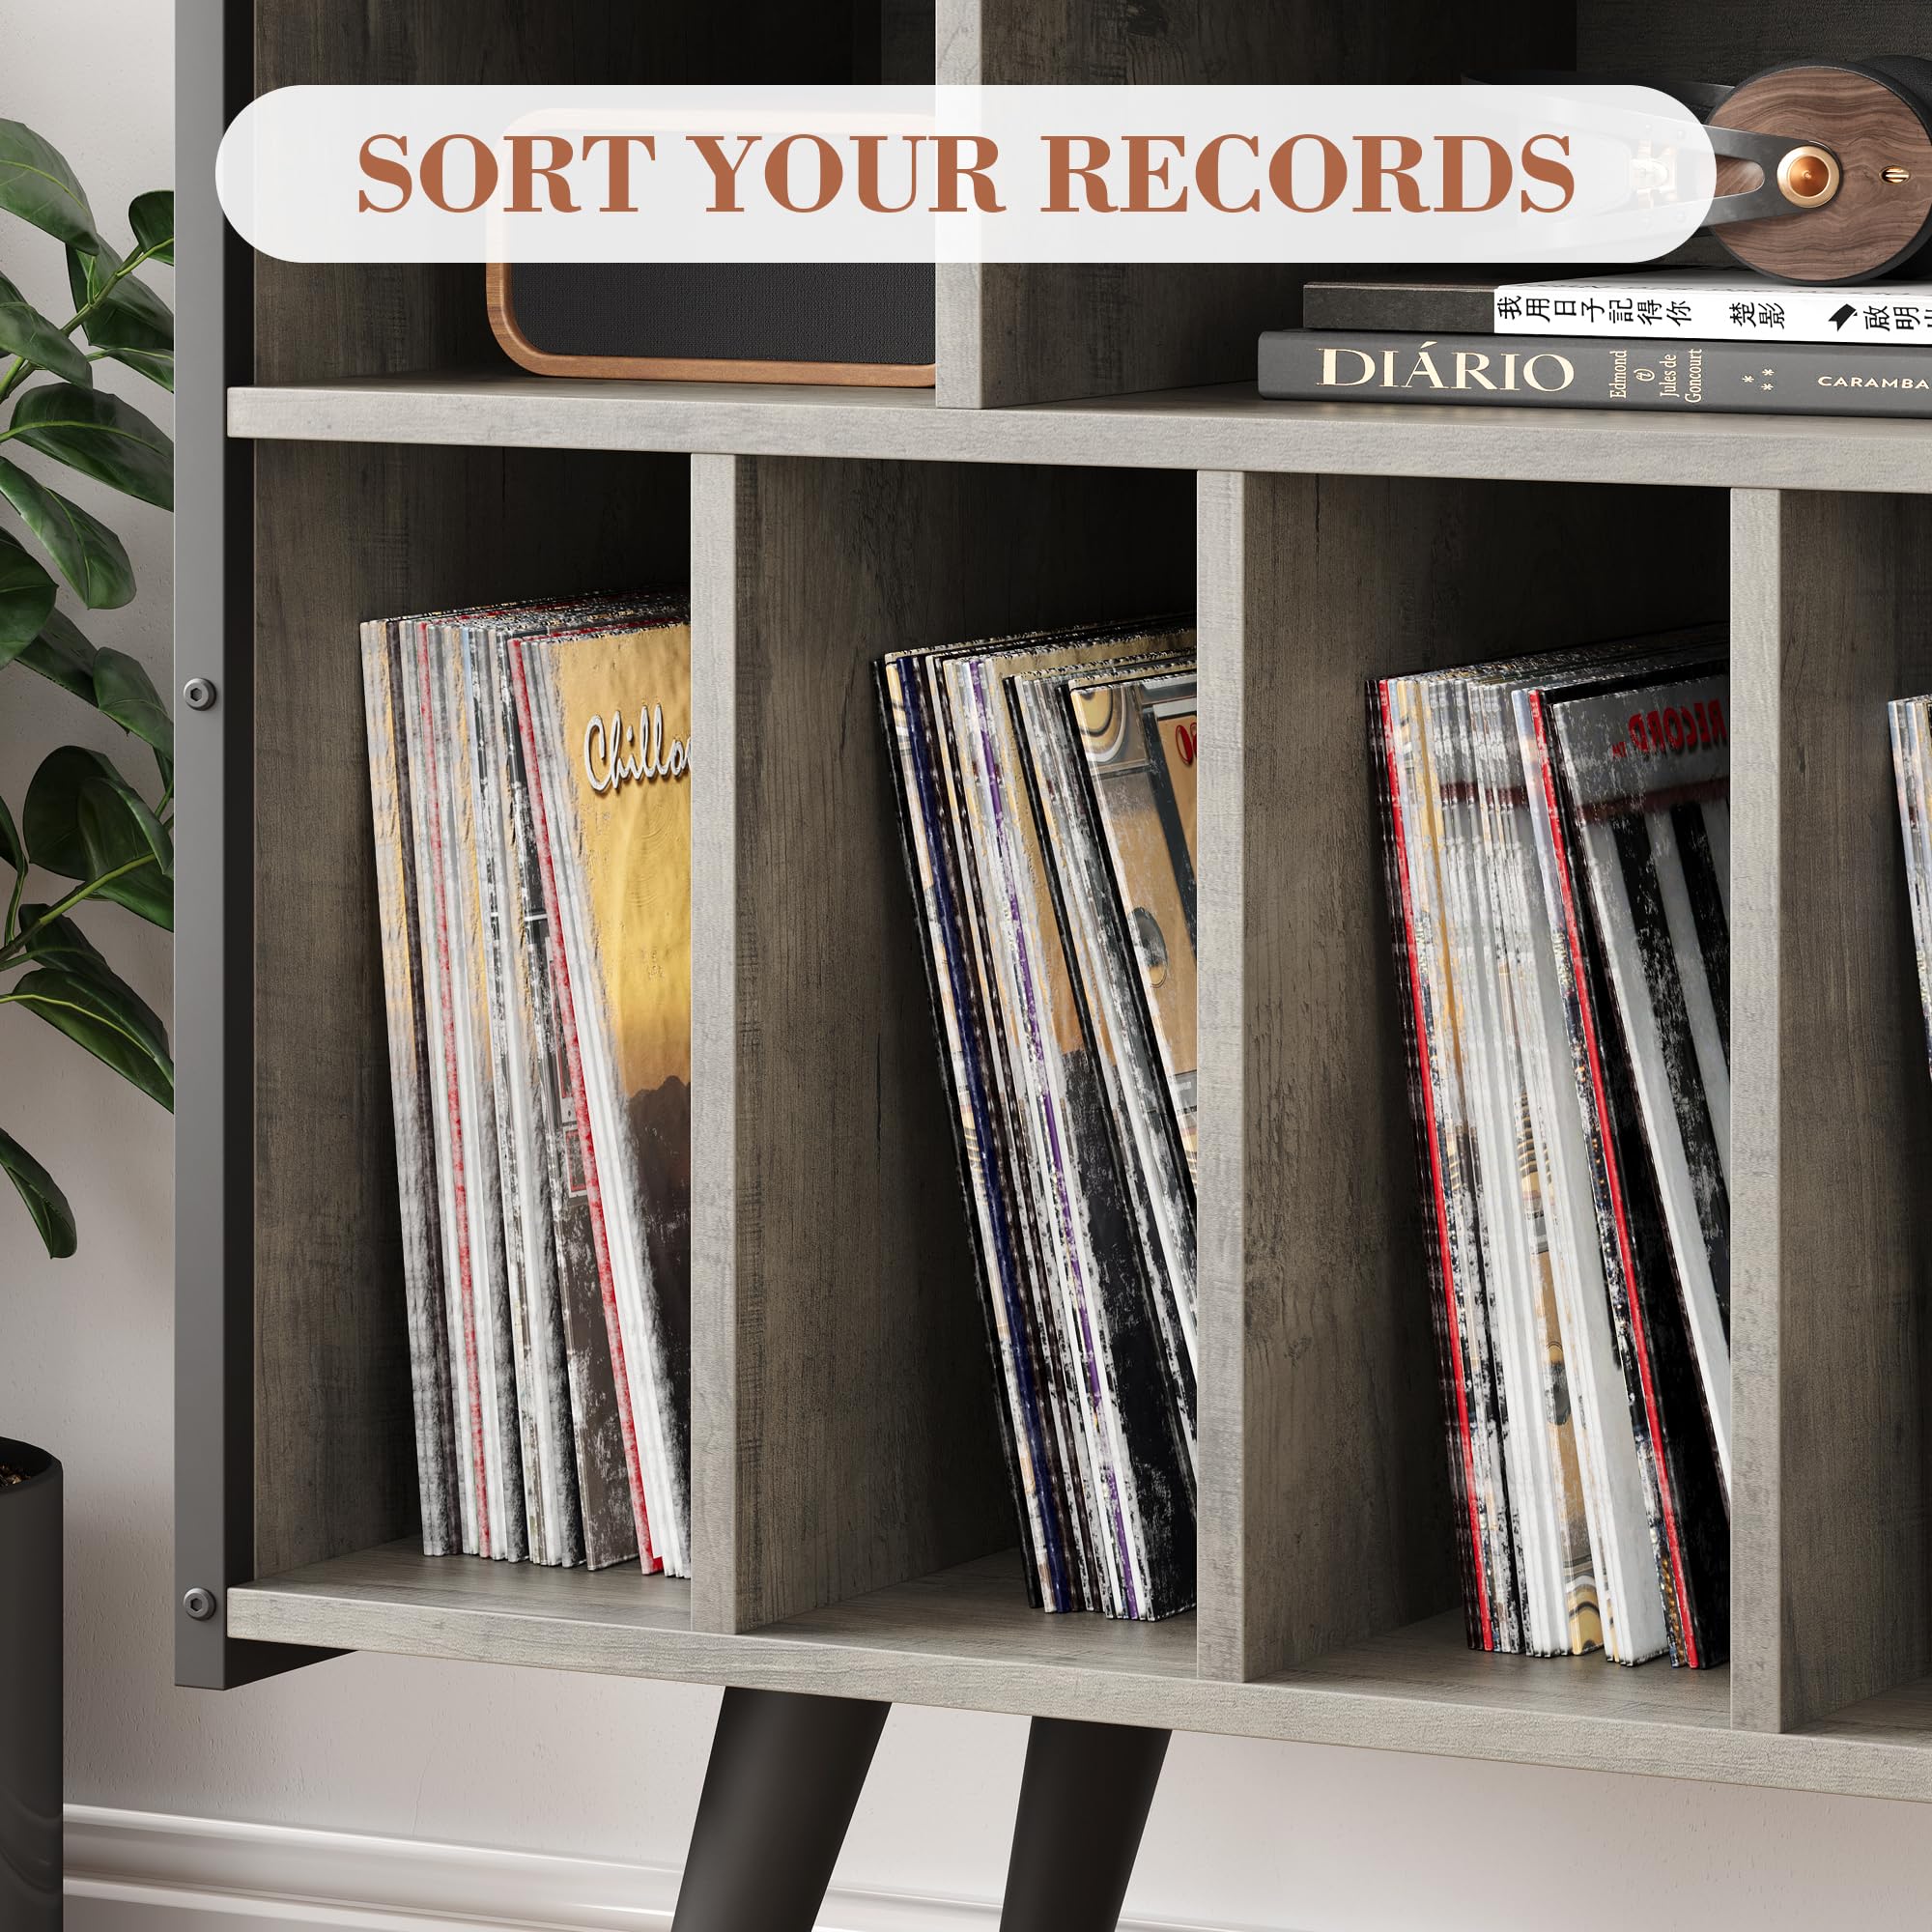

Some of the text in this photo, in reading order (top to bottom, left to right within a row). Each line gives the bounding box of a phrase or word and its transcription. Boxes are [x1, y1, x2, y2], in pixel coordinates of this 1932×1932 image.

[1496, 295, 1692, 327] 我用日子記得你
[1728, 301, 1785, 329] 楚影
[1316, 341, 1575, 392] DIÁRIO
[1608, 350, 1628, 399] Edmond
[1659, 354, 1680, 398] Jules de
[1684, 348, 1703, 403] Goncourt
[1817, 376, 1930, 389] CARAMBA
